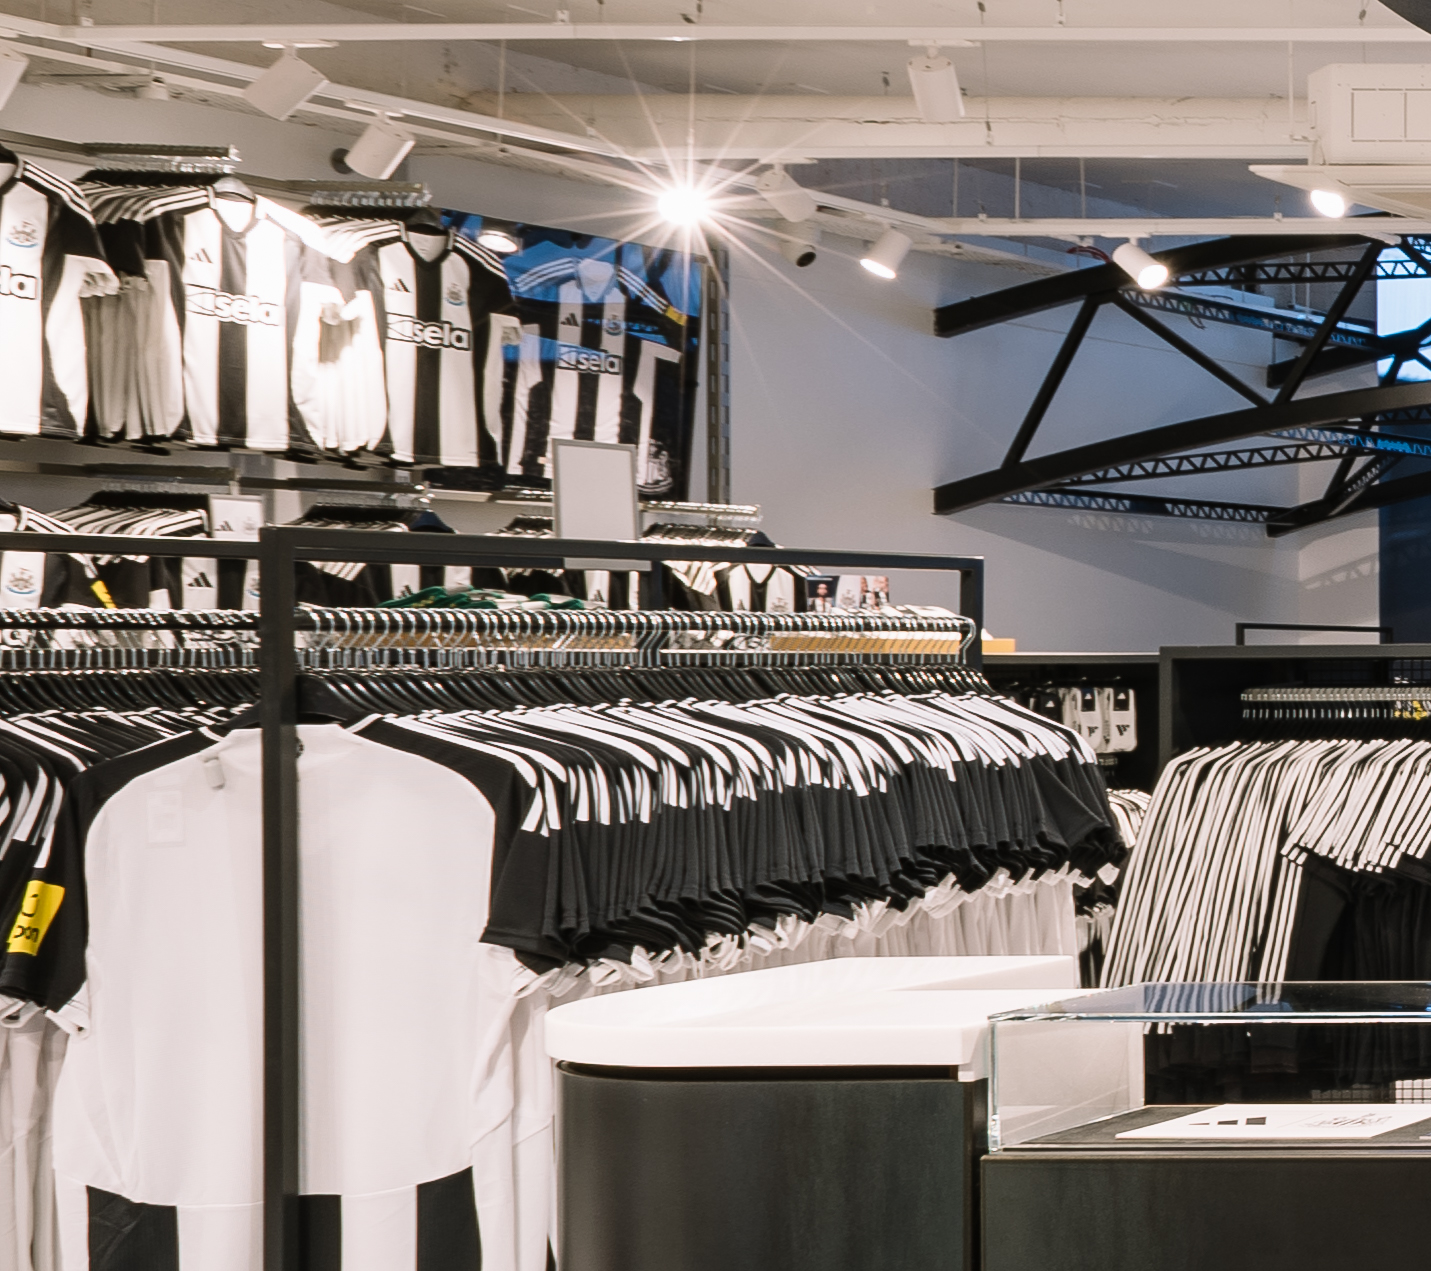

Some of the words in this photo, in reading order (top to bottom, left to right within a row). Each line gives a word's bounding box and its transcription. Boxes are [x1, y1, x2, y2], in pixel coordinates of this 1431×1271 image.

[215, 293, 280, 326] sela
[412, 321, 470, 350] sela
[577, 349, 622, 375] sela
